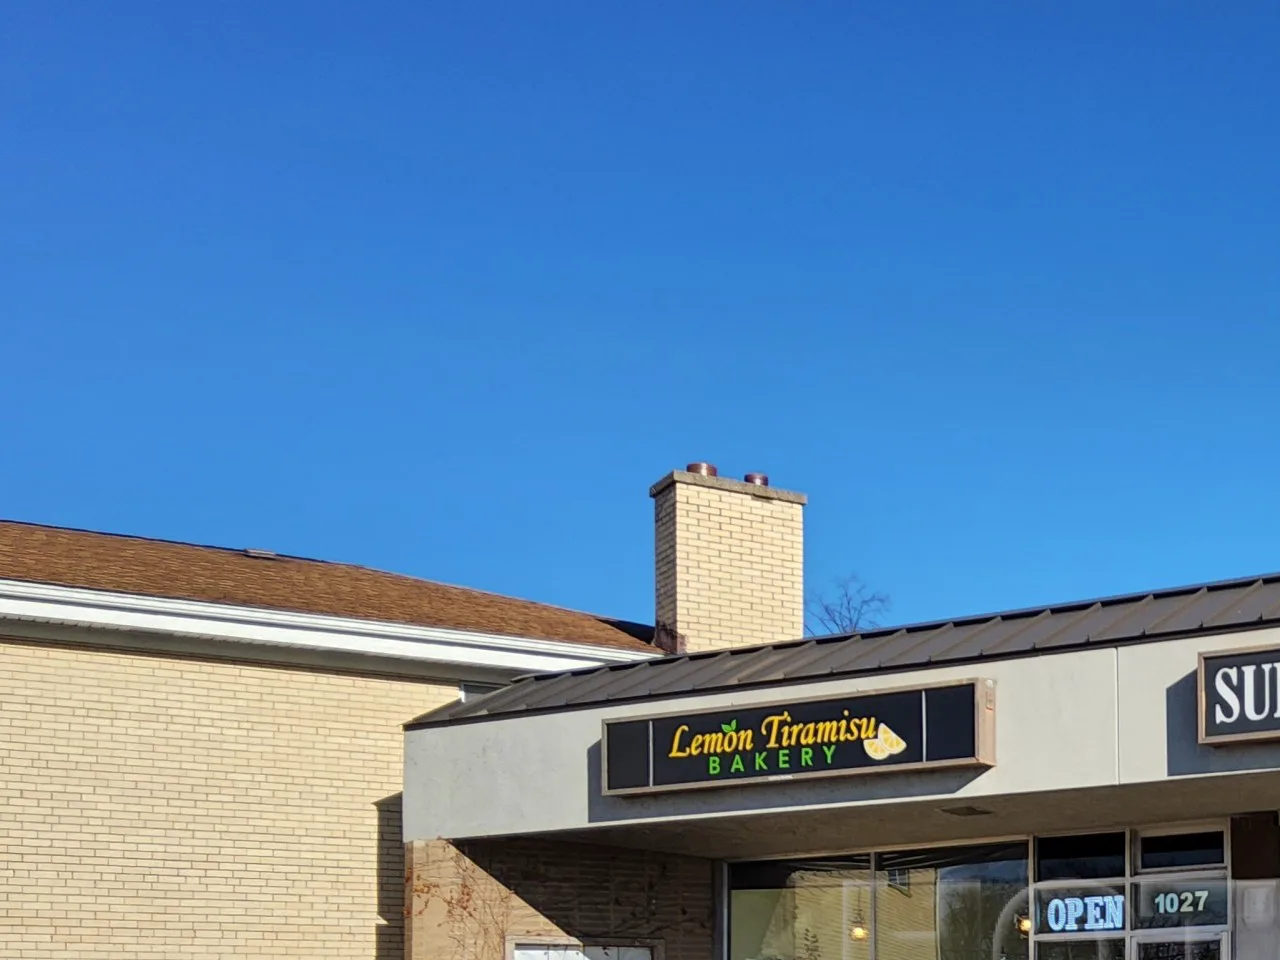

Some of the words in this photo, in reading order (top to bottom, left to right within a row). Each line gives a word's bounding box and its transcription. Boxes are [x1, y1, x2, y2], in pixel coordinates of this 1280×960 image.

[668, 724, 753, 759] Lemon
[761, 709, 877, 748] Tiramisu
[708, 744, 836, 775] BAKERY
[1047, 894, 1125, 931] OPEN
[1154, 890, 1209, 914] 1027
